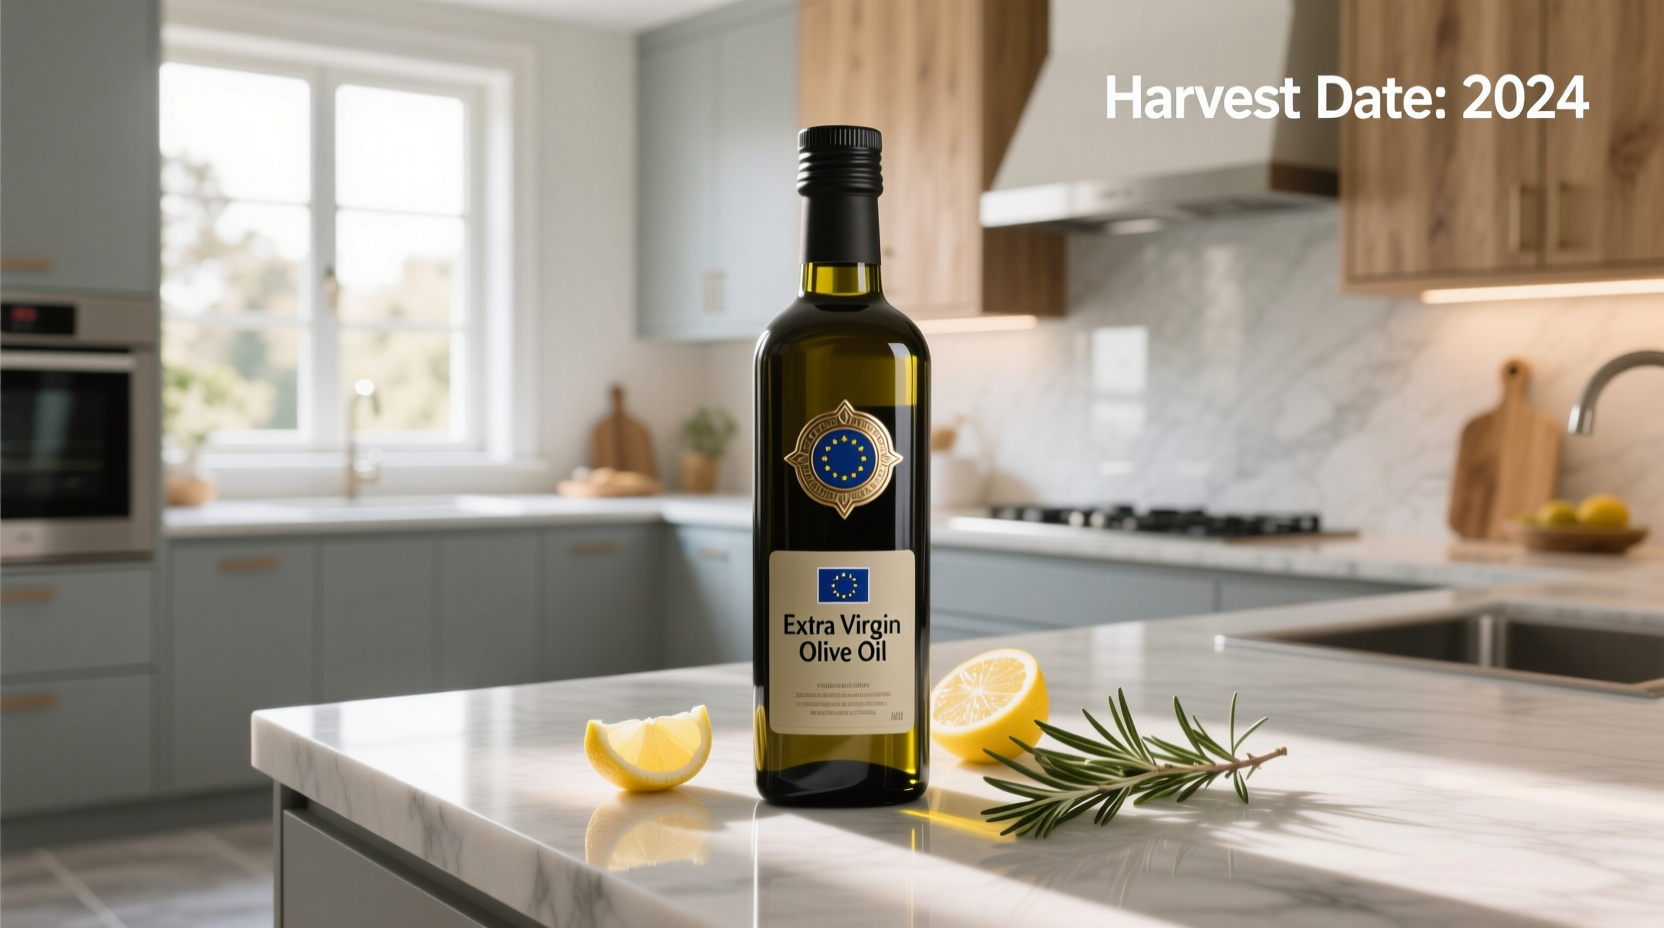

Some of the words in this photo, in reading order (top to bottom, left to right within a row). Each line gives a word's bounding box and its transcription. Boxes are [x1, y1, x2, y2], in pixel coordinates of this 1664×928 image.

[784, 614, 835, 635] Extra
[840, 614, 901, 640] Virgin
[799, 640, 852, 662] Olive
[858, 640, 887, 662] Oil
